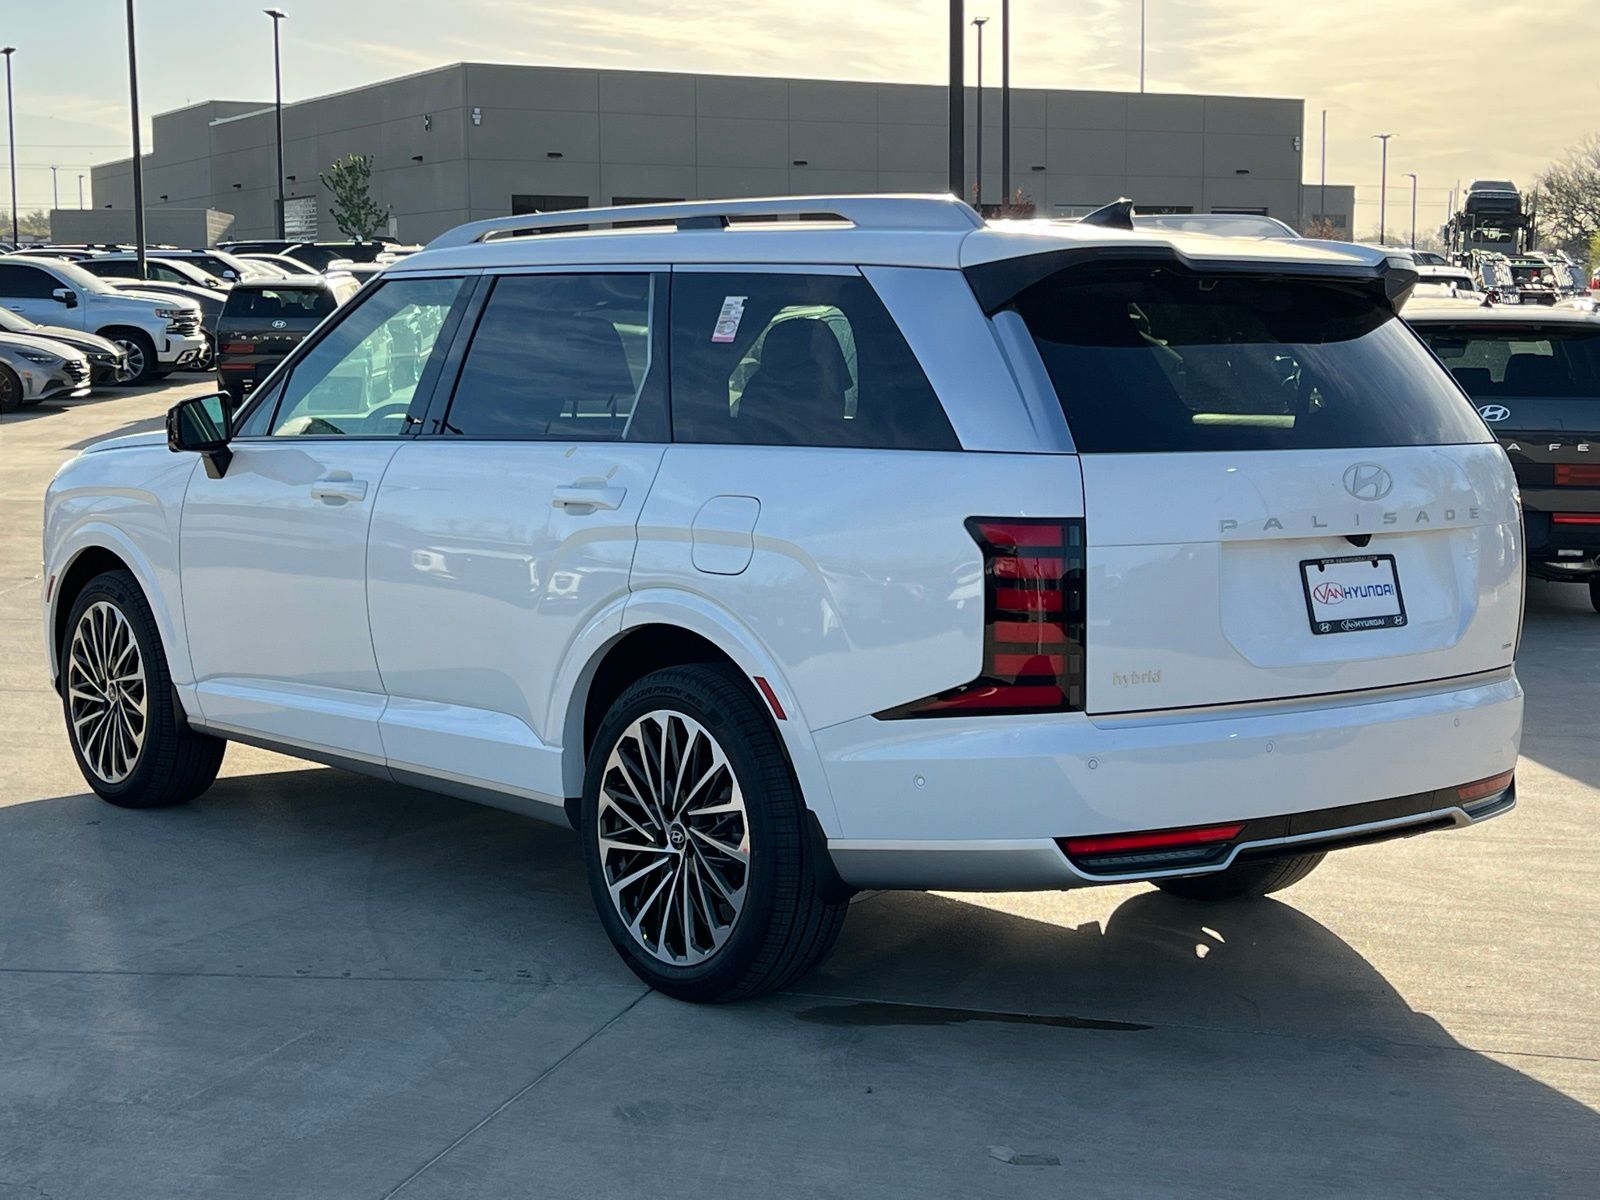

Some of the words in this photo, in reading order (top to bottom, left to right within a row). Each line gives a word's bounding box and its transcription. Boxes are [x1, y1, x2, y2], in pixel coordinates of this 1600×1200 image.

[1548, 443, 1590, 452] FE
[1219, 507, 1481, 533] PALISADE
[1112, 669, 1161, 688] hybrid
[623, 685, 682, 707] SCORPION
